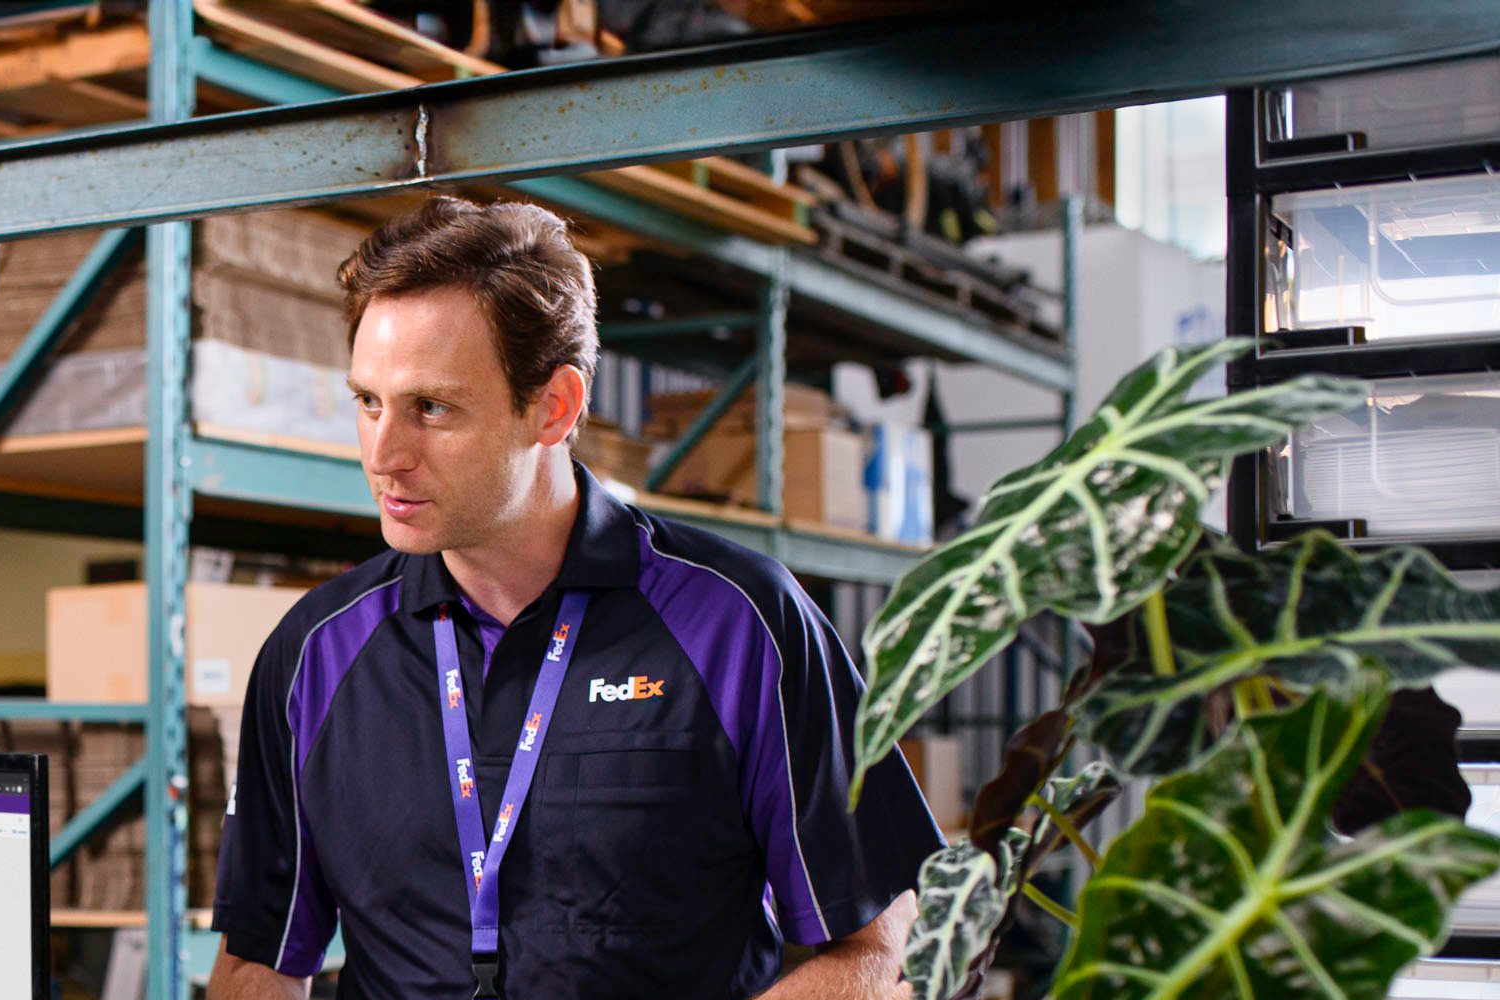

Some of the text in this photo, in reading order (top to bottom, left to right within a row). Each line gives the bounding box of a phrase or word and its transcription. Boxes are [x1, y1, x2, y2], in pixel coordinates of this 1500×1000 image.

[547, 623, 570, 662] FedEx
[445, 668, 461, 709] FedEx
[588, 675, 665, 703] FedEx
[519, 711, 542, 752] FedEx
[456, 757, 474, 799] FedEx
[493, 803, 514, 843] FedEx
[470, 850, 485, 892] FedE
